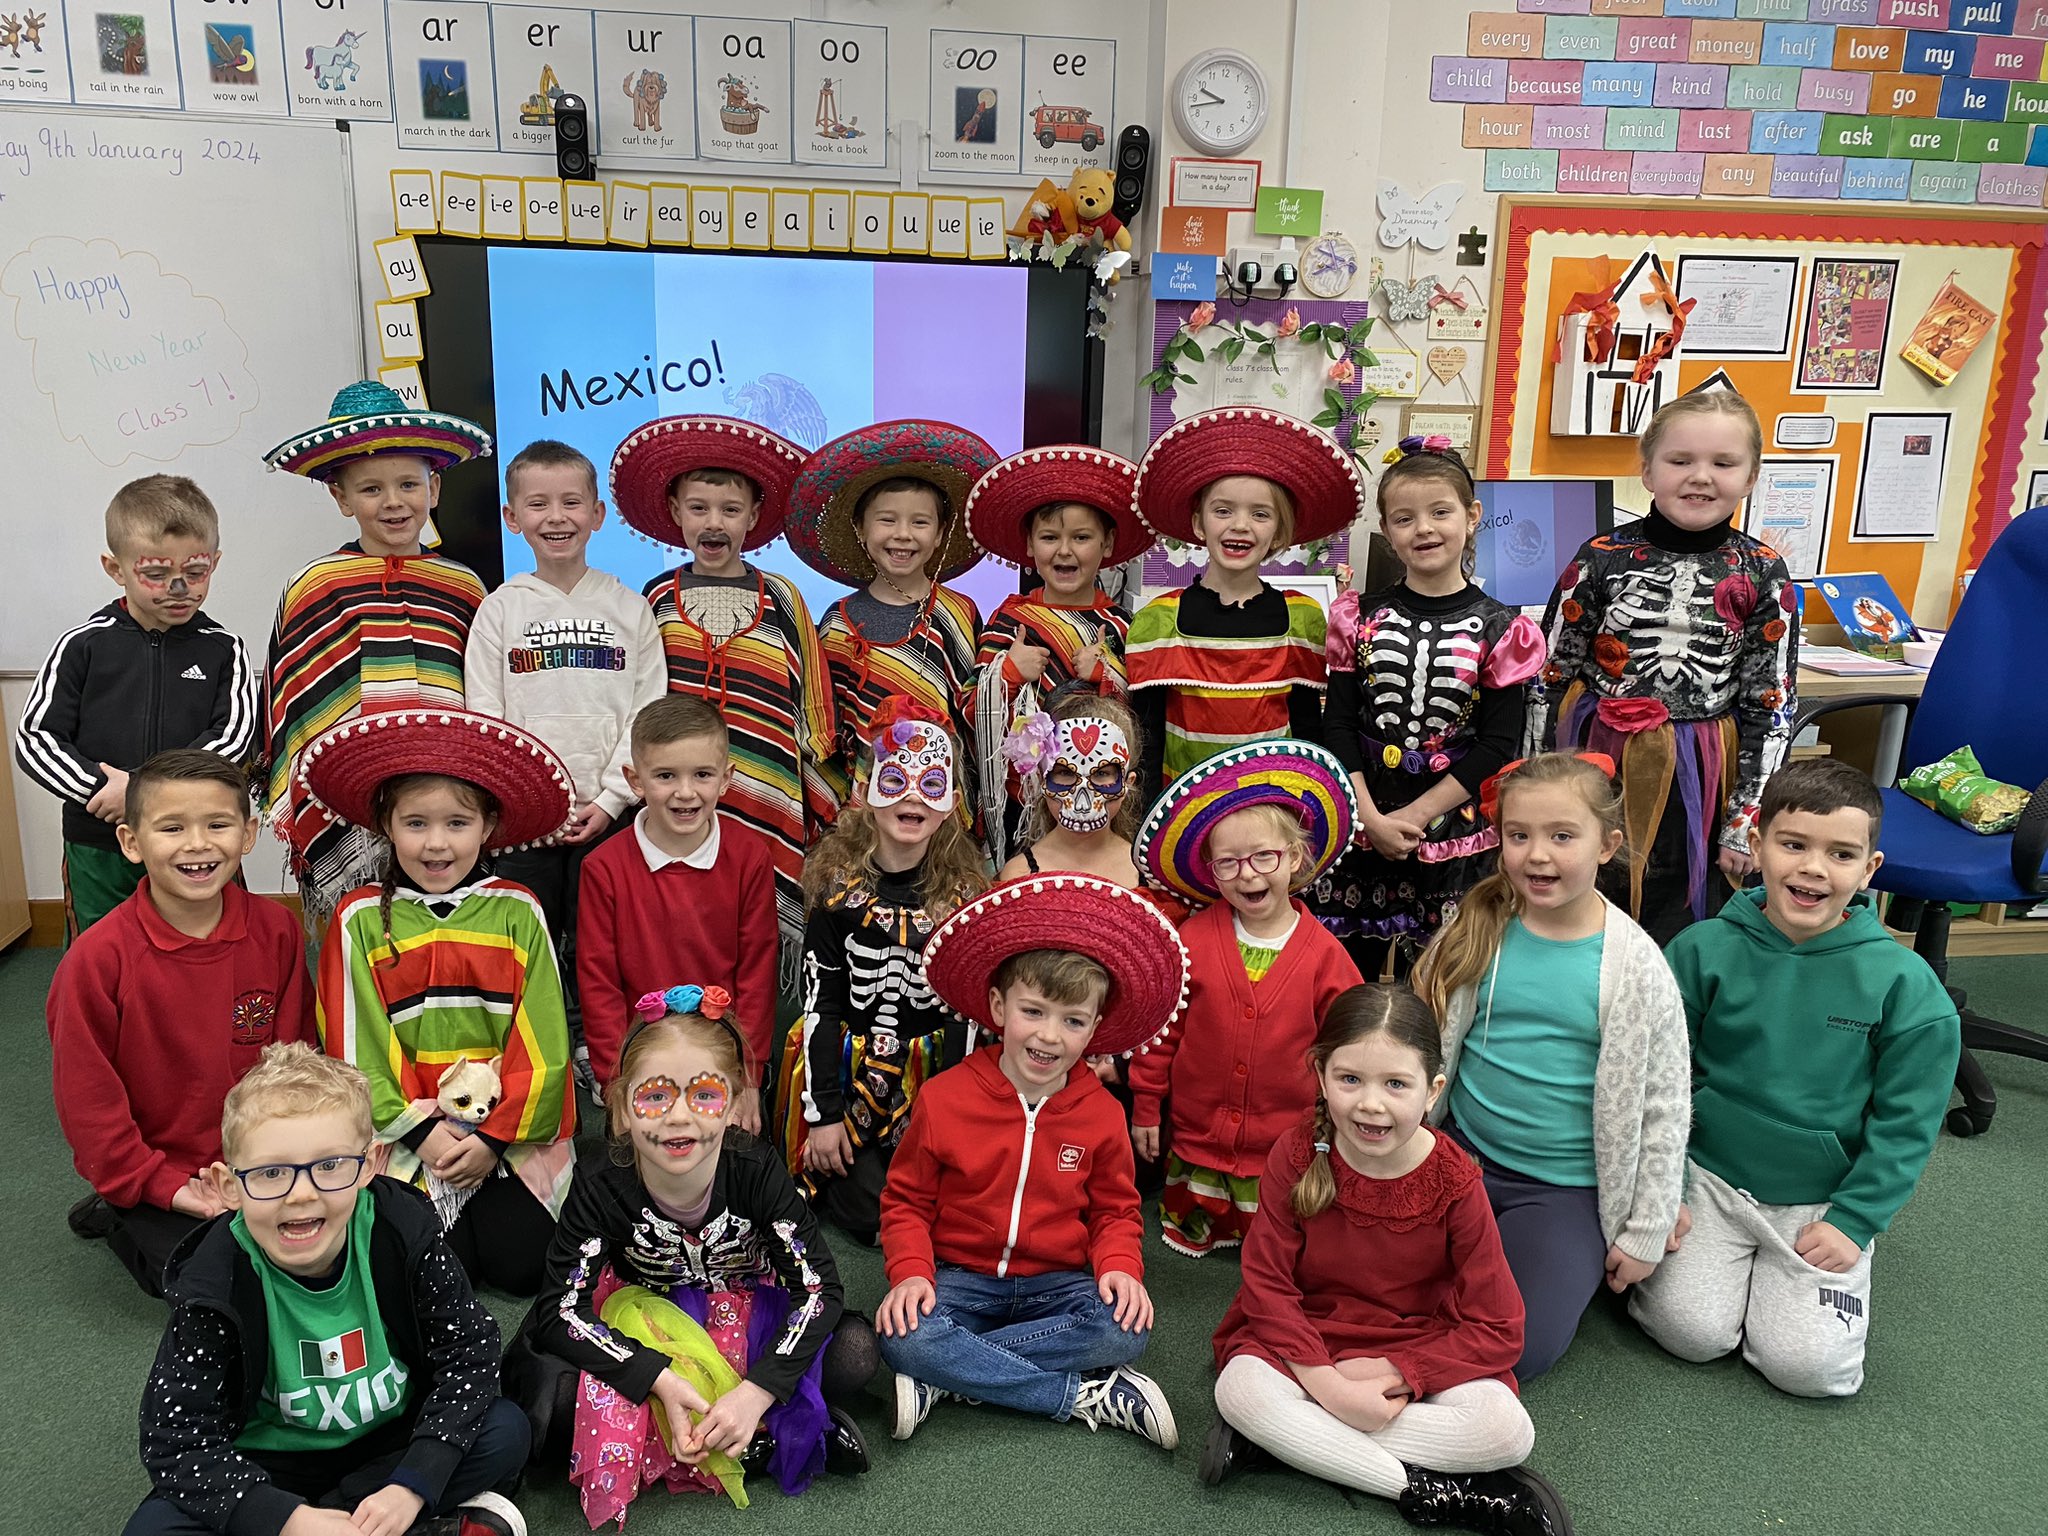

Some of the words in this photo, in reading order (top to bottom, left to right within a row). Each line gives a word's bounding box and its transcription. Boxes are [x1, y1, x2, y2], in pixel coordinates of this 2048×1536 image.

[1821, 0, 1868, 16] grass
[1890, 0, 1940, 20] push
[1965, 2, 2001, 26] pull
[2031, 8, 2048, 30] fa
[422, 17, 458, 42] ar
[527, 23, 560, 47] er
[628, 28, 663, 52] ur
[722, 34, 765, 58] oa
[1481, 32, 1530, 51] every
[1560, 34, 1600, 50] even
[1630, 32, 1677, 54] great
[1696, 38, 1754, 57] money
[1780, 36, 1818, 61] half
[1850, 38, 1890, 60] love
[820, 38, 860, 63] oo
[956, 48, 997, 70] oo
[1924, 48, 1954, 70] my
[1994, 51, 2024, 68] me
[1054, 54, 1087, 76] ee
[1222, 68, 1230, 78] 12
[18, 78, 48, 92] boing
[1199, 80, 1206, 88] 10
[1208, 72, 1216, 80] 11
[1236, 74, 1240, 82] 1
[1446, 68, 1492, 88] child
[1508, 75, 1580, 94] because
[90, 82, 106, 92] tail
[110, 83, 120, 92] in
[124, 83, 140, 93] the
[144, 85, 164, 94] rain
[1244, 85, 1249, 94] 2
[1592, 78, 1642, 98] many
[1671, 76, 1712, 95] kind
[1744, 82, 1782, 101] hold
[1814, 83, 1854, 106] busy
[213, 92, 236, 100] wow
[241, 92, 259, 102] owl
[298, 94, 321, 106] born
[324, 96, 346, 106] with
[360, 98, 383, 108] horn
[1192, 94, 1198, 102] 9
[1246, 101, 1252, 109] 3
[1892, 88, 1916, 108] go
[1964, 88, 1986, 110] he
[1195, 109, 1200, 118] 8
[404, 126, 434, 136] march
[438, 126, 448, 136] in
[450, 126, 466, 137] the
[469, 126, 491, 138] dark
[1216, 126, 1221, 134] 6
[1230, 124, 1234, 132] 5
[1480, 118, 1522, 136] hour
[1547, 122, 1590, 140] most
[1619, 120, 1665, 138] mind
[1698, 121, 1731, 140] last
[1764, 120, 1806, 143] after
[1839, 125, 1873, 146] ask
[512, 132, 519, 140] a
[522, 130, 552, 144] bigger
[622, 136, 640, 146] curl
[643, 136, 658, 146] the
[660, 138, 674, 148] fur
[712, 140, 732, 150] soap
[736, 140, 754, 150] that
[758, 142, 778, 152] goat
[1910, 131, 1941, 148] are
[1987, 137, 1999, 152] a
[39, 128, 76, 158] 9th
[88, 130, 182, 176] January
[202, 138, 260, 165] 2024
[811, 142, 834, 152] hook
[846, 144, 868, 154] book
[934, 152, 958, 160] zoom
[962, 152, 970, 160] to
[974, 152, 988, 160] the
[990, 154, 1015, 162] moon
[1034, 154, 1058, 166] sheep
[1062, 155, 1070, 164] in
[1081, 156, 1098, 168] jeep
[1200, 174, 1218, 182] many
[1220, 173, 1236, 181] hours
[1502, 162, 1542, 180] both
[1559, 165, 1628, 182] children
[1632, 170, 1700, 187] everybody
[1722, 166, 1754, 186] any
[1774, 167, 1839, 189] beautiful
[1848, 170, 1905, 190] behind
[1215, 184, 1230, 192] day?
[1920, 172, 1968, 193] again
[1982, 176, 2040, 196] clothes
[400, 190, 429, 207] a-e
[448, 194, 476, 212] e-e
[491, 194, 513, 212] i-e
[529, 198, 558, 214] o-e
[1274, 198, 1303, 214] thank
[571, 200, 600, 218] u-e
[623, 202, 637, 220] ir
[658, 204, 682, 222] ea
[698, 208, 722, 232] oy
[744, 210, 757, 228] e
[784, 212, 799, 232] a
[828, 208, 834, 230] i
[865, 215, 878, 233] o
[904, 214, 918, 234] u
[939, 215, 960, 233] ue
[979, 217, 994, 236] ie
[1276, 213, 1301, 226] you
[1392, 212, 1438, 230] Dreaming
[390, 258, 417, 282] ay
[1174, 260, 1192, 273] Make
[32, 266, 130, 320] Happy
[1170, 276, 1196, 292] happen
[1946, 292, 1968, 311] FIRE
[1968, 309, 1989, 326] CAT
[386, 322, 414, 338] ou
[88, 350, 146, 376] New
[151, 330, 206, 361] Year
[541, 339, 725, 416] Mexico!
[116, 401, 188, 438] Class
[1476, 508, 1514, 532] exico!
[524, 618, 615, 635] MARVEL
[525, 632, 614, 648] COMICS
[510, 648, 562, 672] SUPER
[568, 648, 625, 670] HEROES
[1819, 1288, 1862, 1317] PUMA
